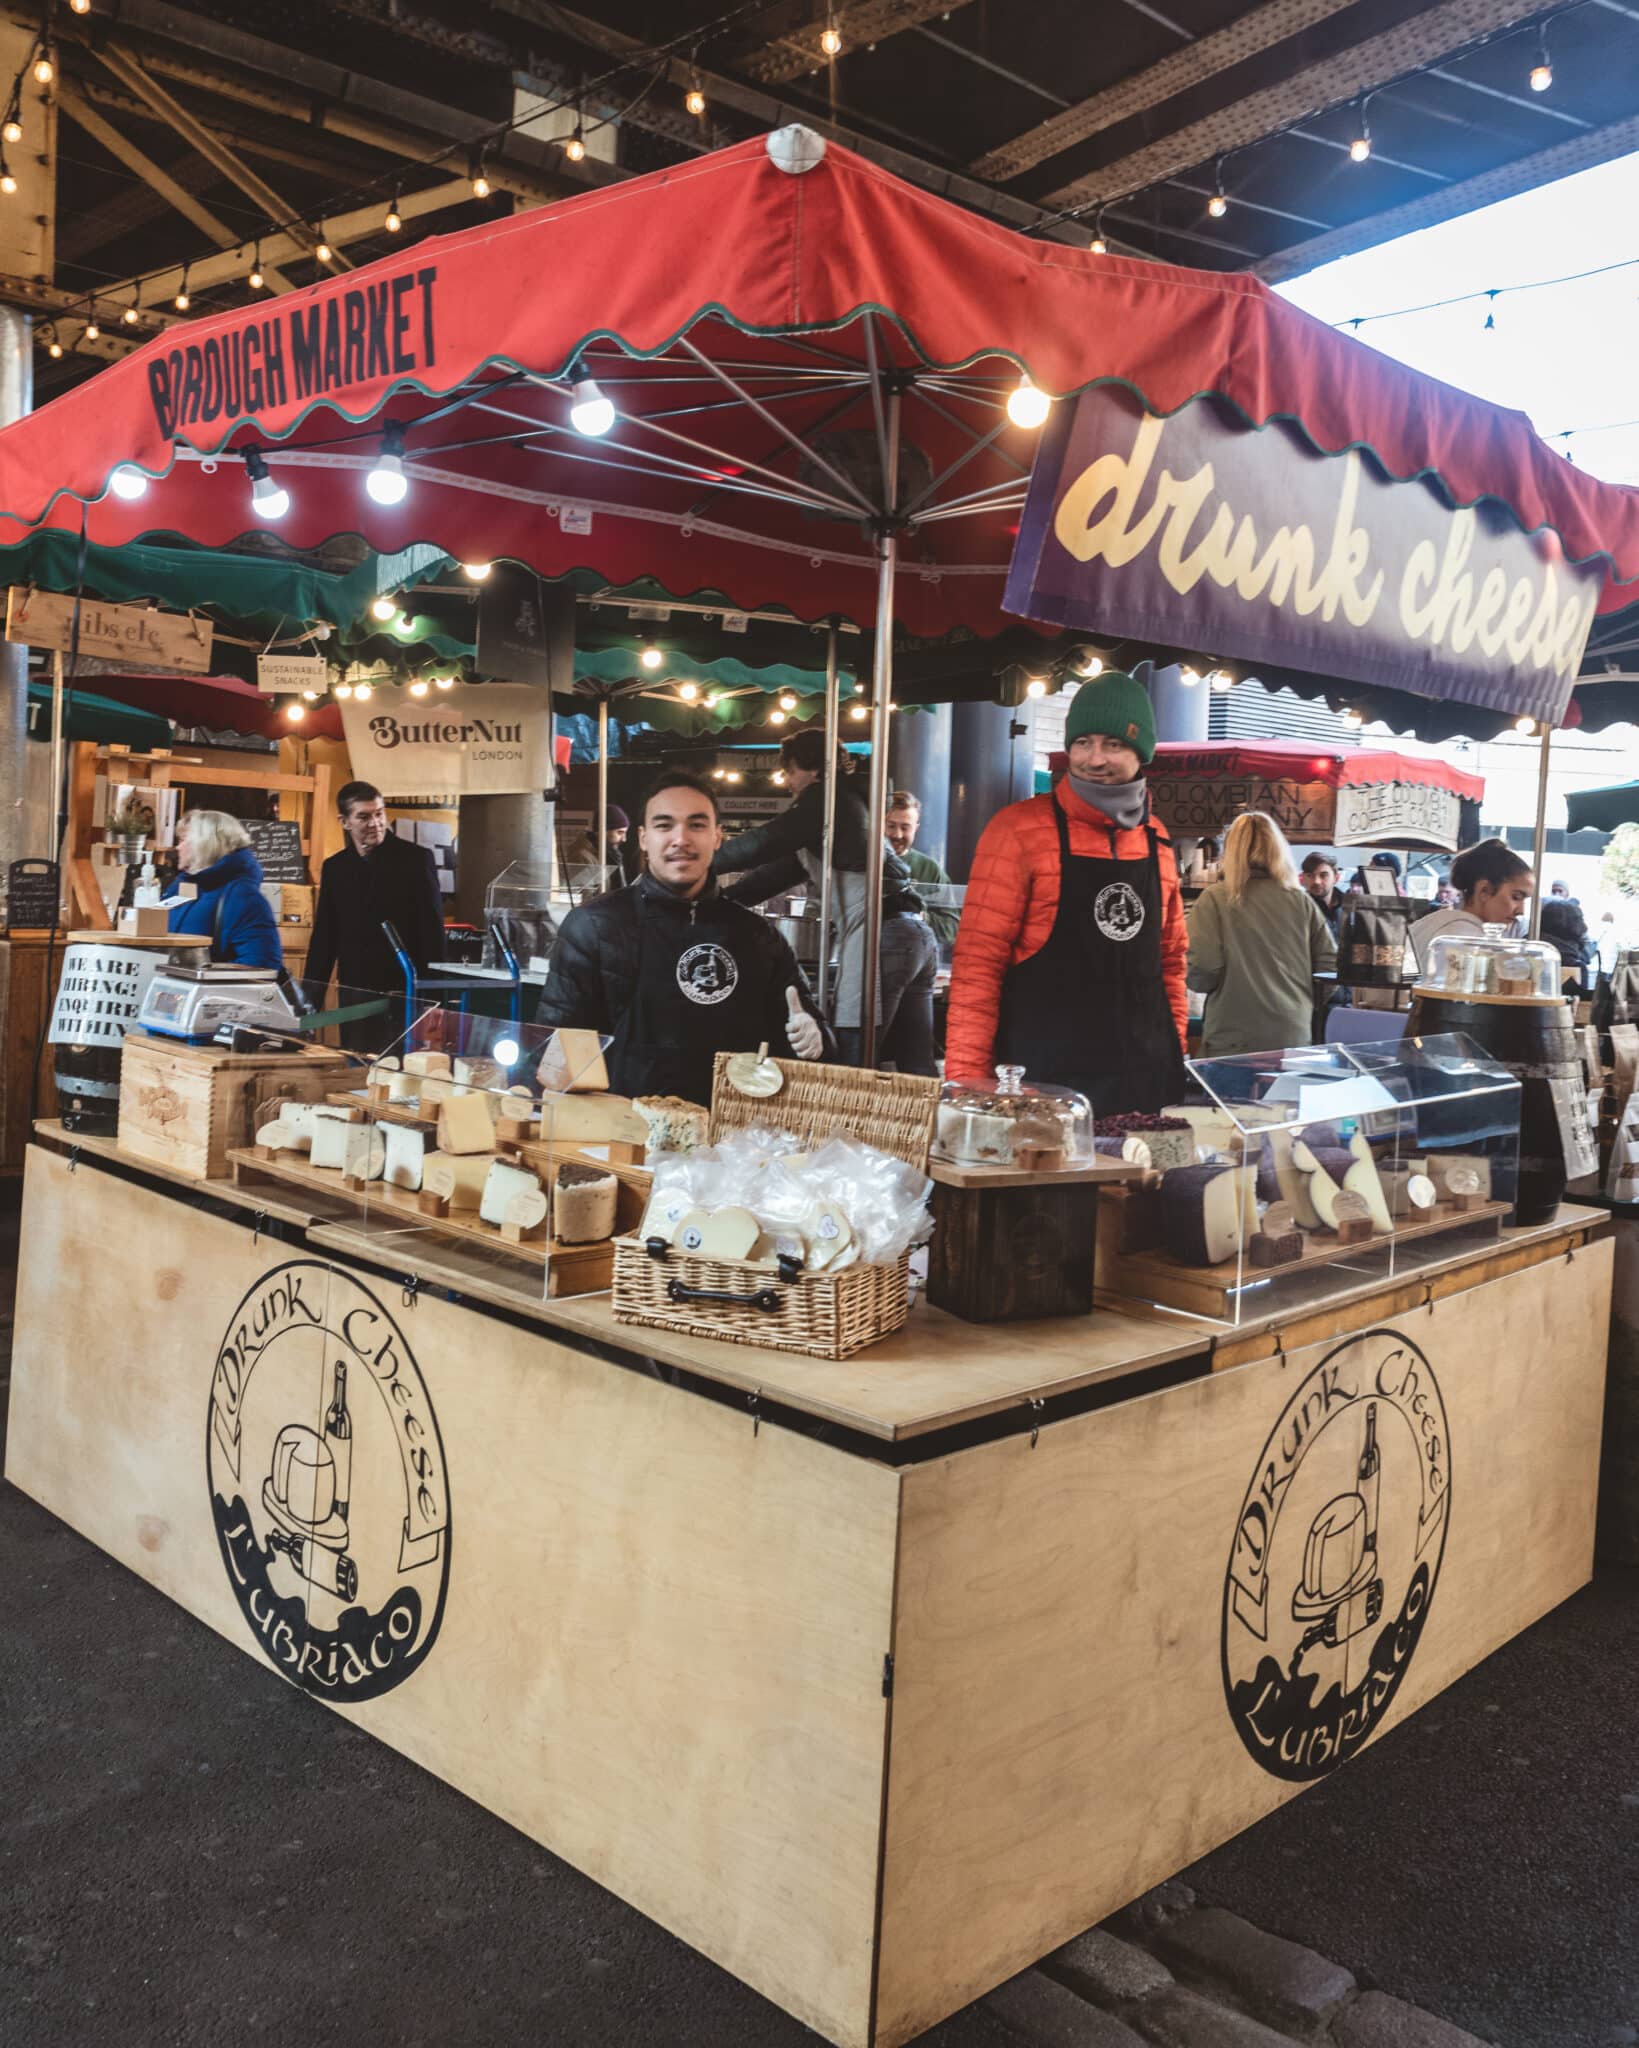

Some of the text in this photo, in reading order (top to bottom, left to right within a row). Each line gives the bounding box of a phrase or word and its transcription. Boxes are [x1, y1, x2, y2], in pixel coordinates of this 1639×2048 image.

[148, 266, 437, 442] BOROUGH MARKET
[1054, 416, 1384, 627] drunk
[261, 664, 324, 675] SUSTAINABLE
[273, 676, 311, 685] SNACKS
[369, 715, 522, 749] ButterNut
[472, 750, 523, 761] LONDON
[1173, 805, 1313, 827] COMPNY
[68, 958, 140, 977] WE ARE
[63, 978, 138, 997] HIRING!
[58, 1019, 128, 1037] WITHIN
[343, 1308, 439, 1524] Cheese
[1375, 1348, 1444, 1497] Cheese
